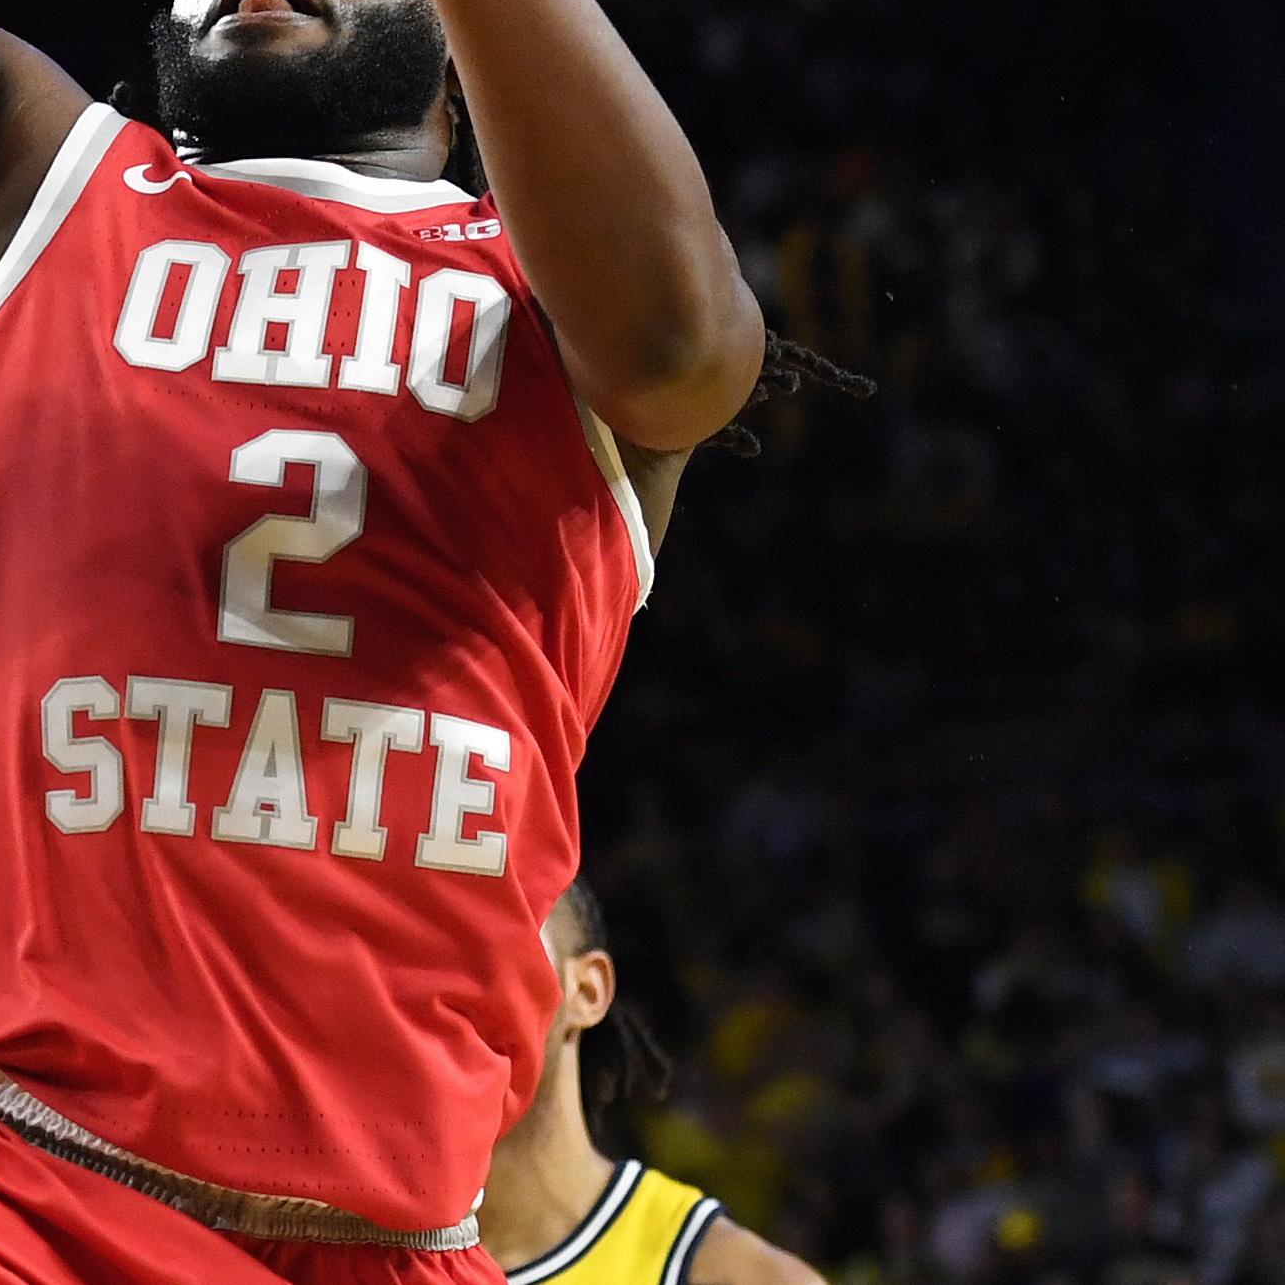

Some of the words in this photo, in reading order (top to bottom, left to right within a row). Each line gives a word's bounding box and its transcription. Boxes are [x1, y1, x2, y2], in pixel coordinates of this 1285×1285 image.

[112, 239, 512, 423] OHIO
[216, 428, 368, 657] 2
[40, 674, 511, 878] STATE
